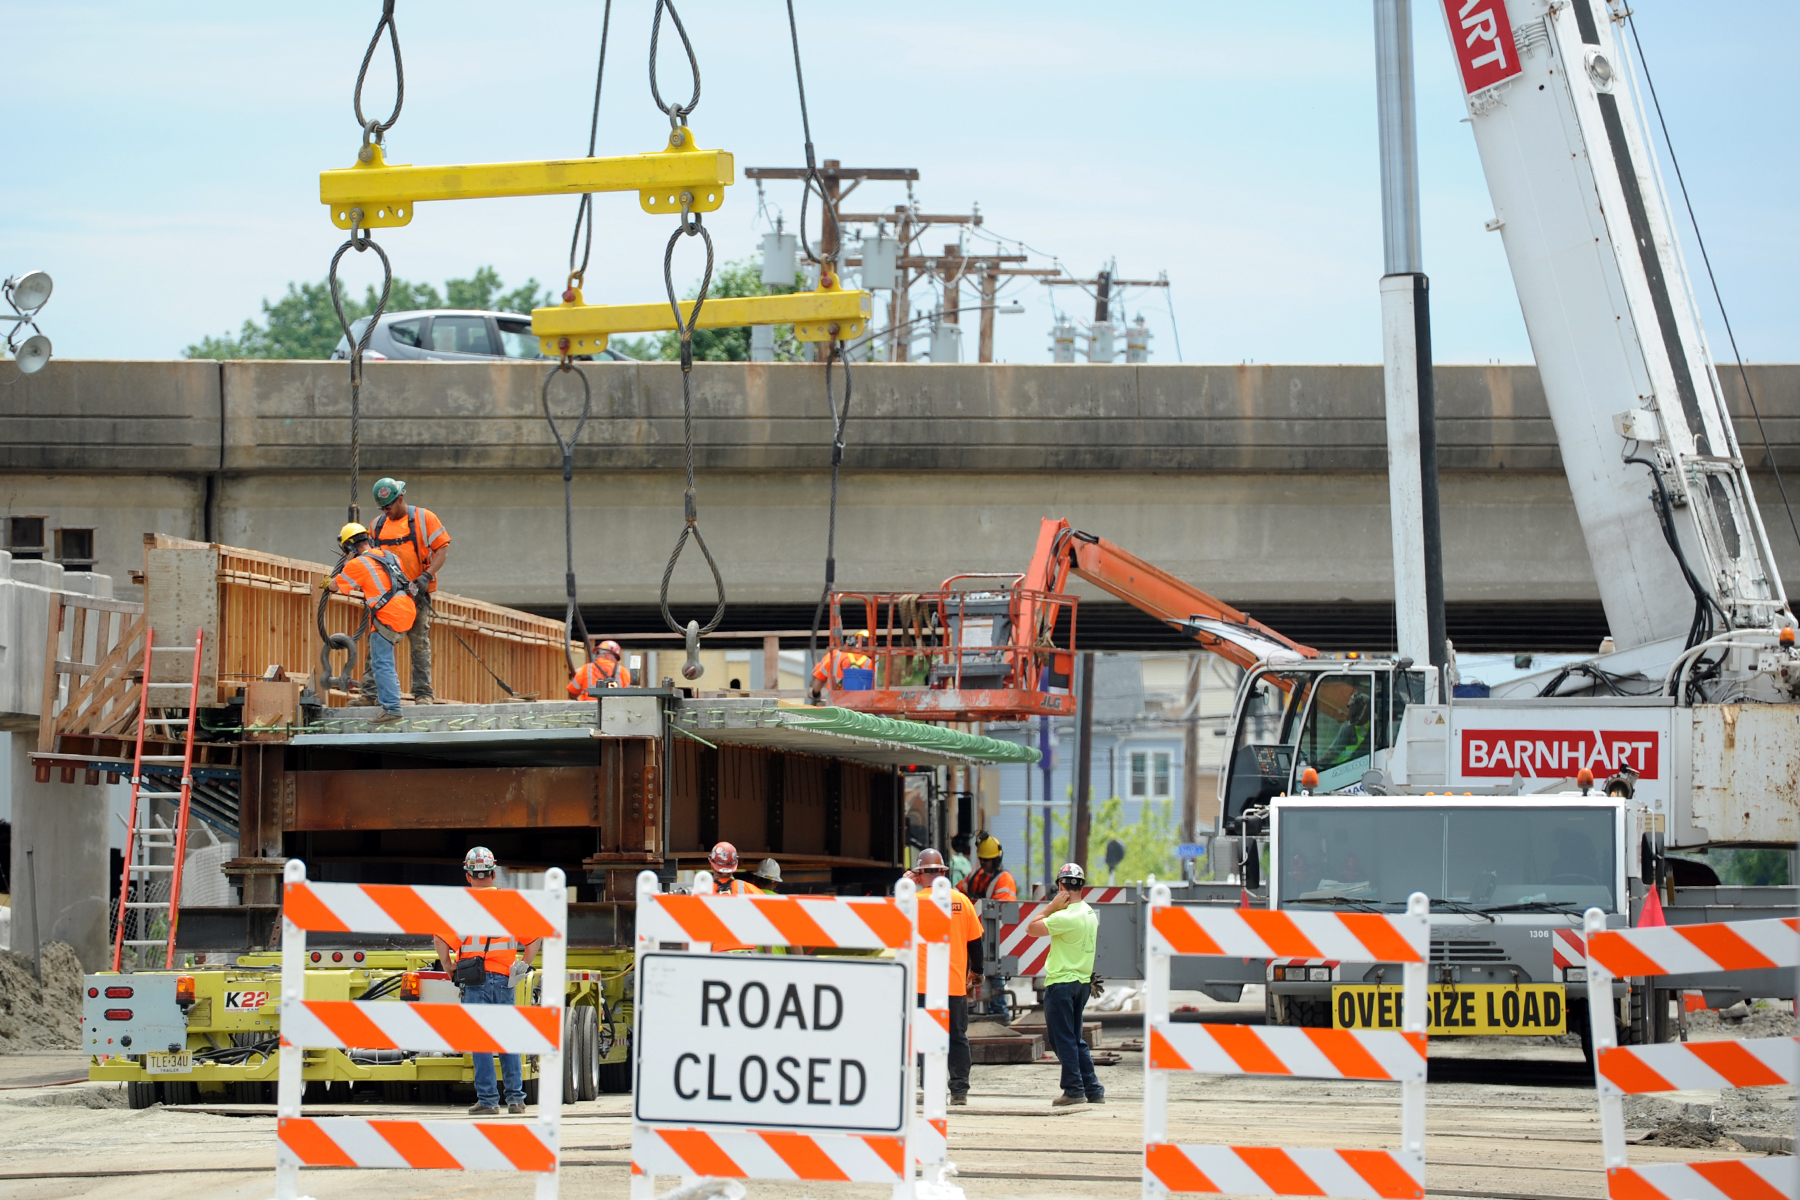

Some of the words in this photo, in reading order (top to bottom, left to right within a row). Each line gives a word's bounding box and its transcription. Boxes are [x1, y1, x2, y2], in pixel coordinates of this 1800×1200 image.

[1040, 695, 1062, 709] JLG
[1469, 731, 1653, 777] BARNHART
[1431, 926, 1480, 938] EMAG
[1529, 930, 1549, 938] 1306
[700, 979, 844, 1031] ROAD
[1487, 990, 1561, 1028] LOAD
[673, 1052, 867, 1106] CLOSED
